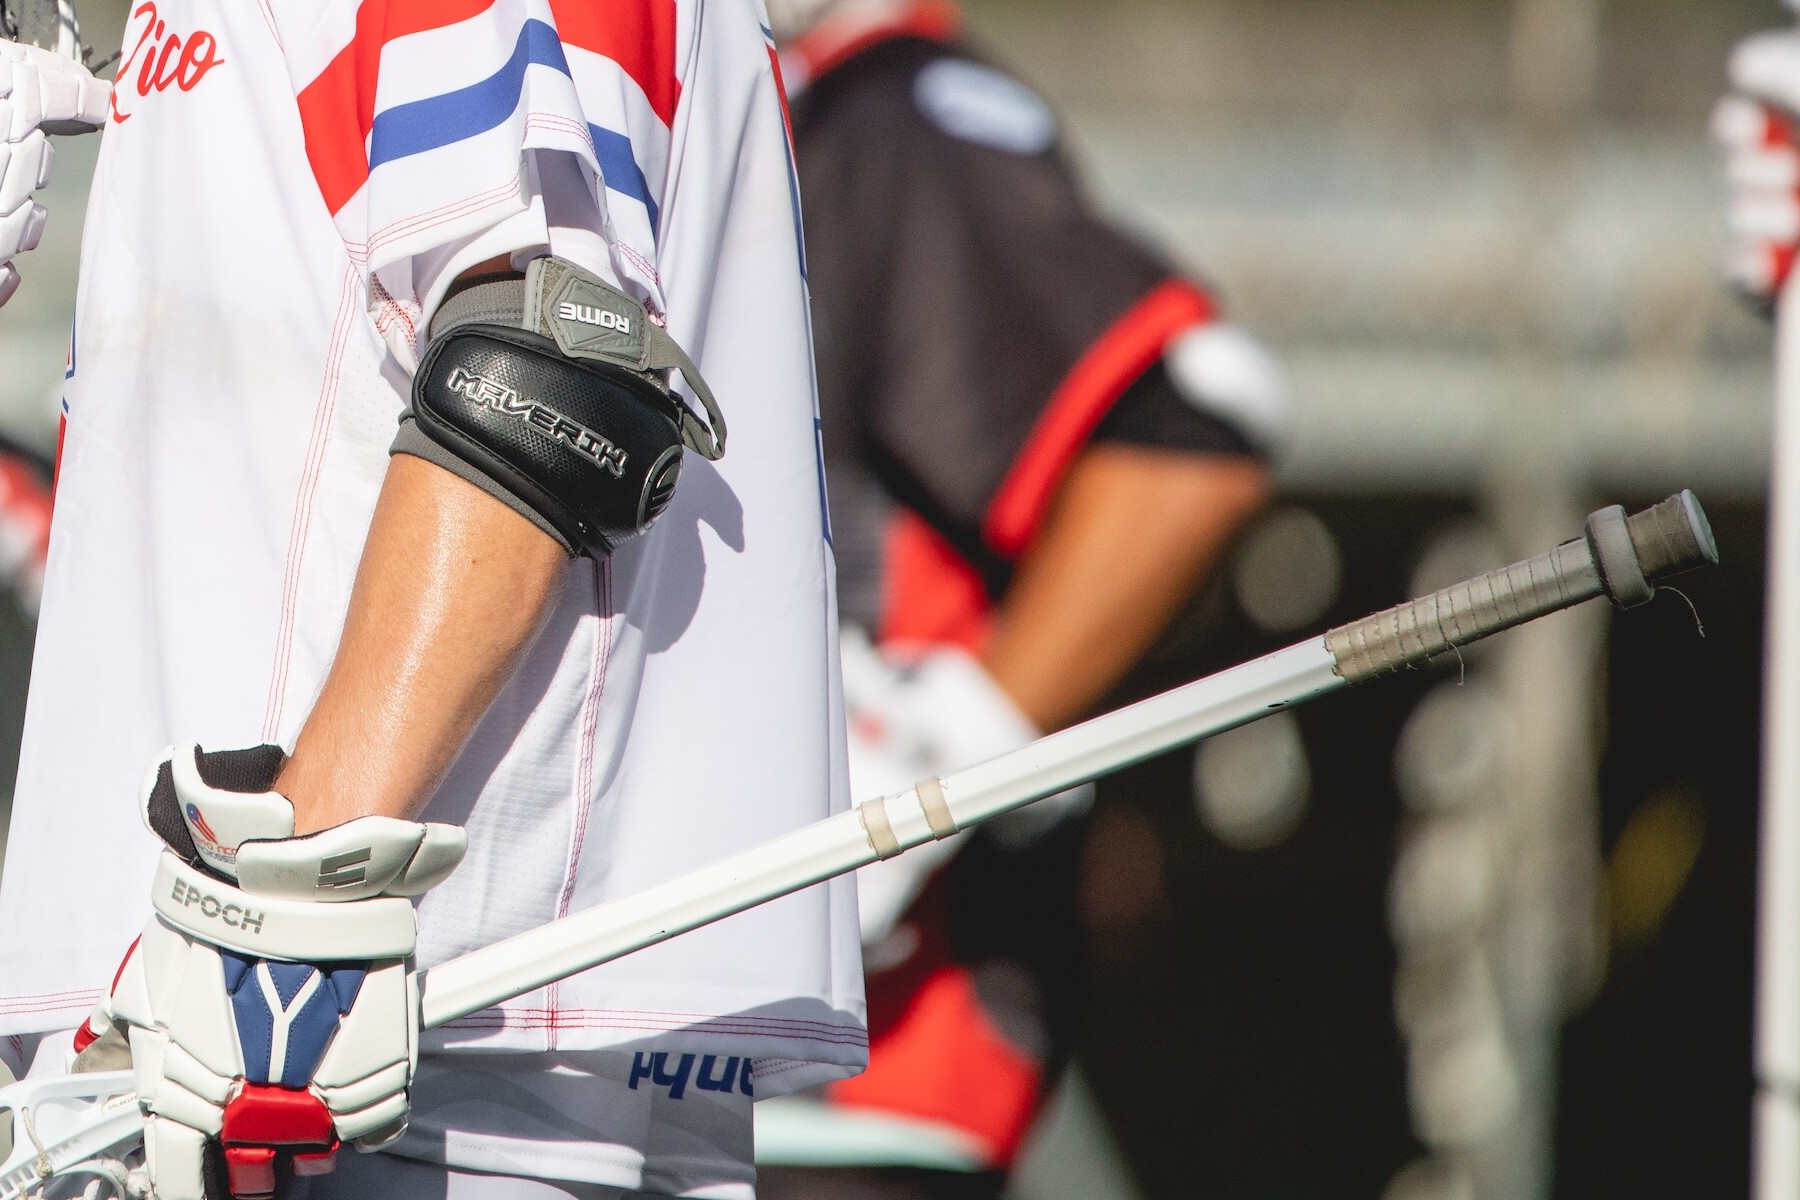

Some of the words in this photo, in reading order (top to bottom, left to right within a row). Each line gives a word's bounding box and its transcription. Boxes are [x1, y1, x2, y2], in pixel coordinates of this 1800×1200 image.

[559, 302, 630, 334] ROME
[447, 367, 630, 479] MAVERIK
[171, 876, 266, 935] EPOCH
